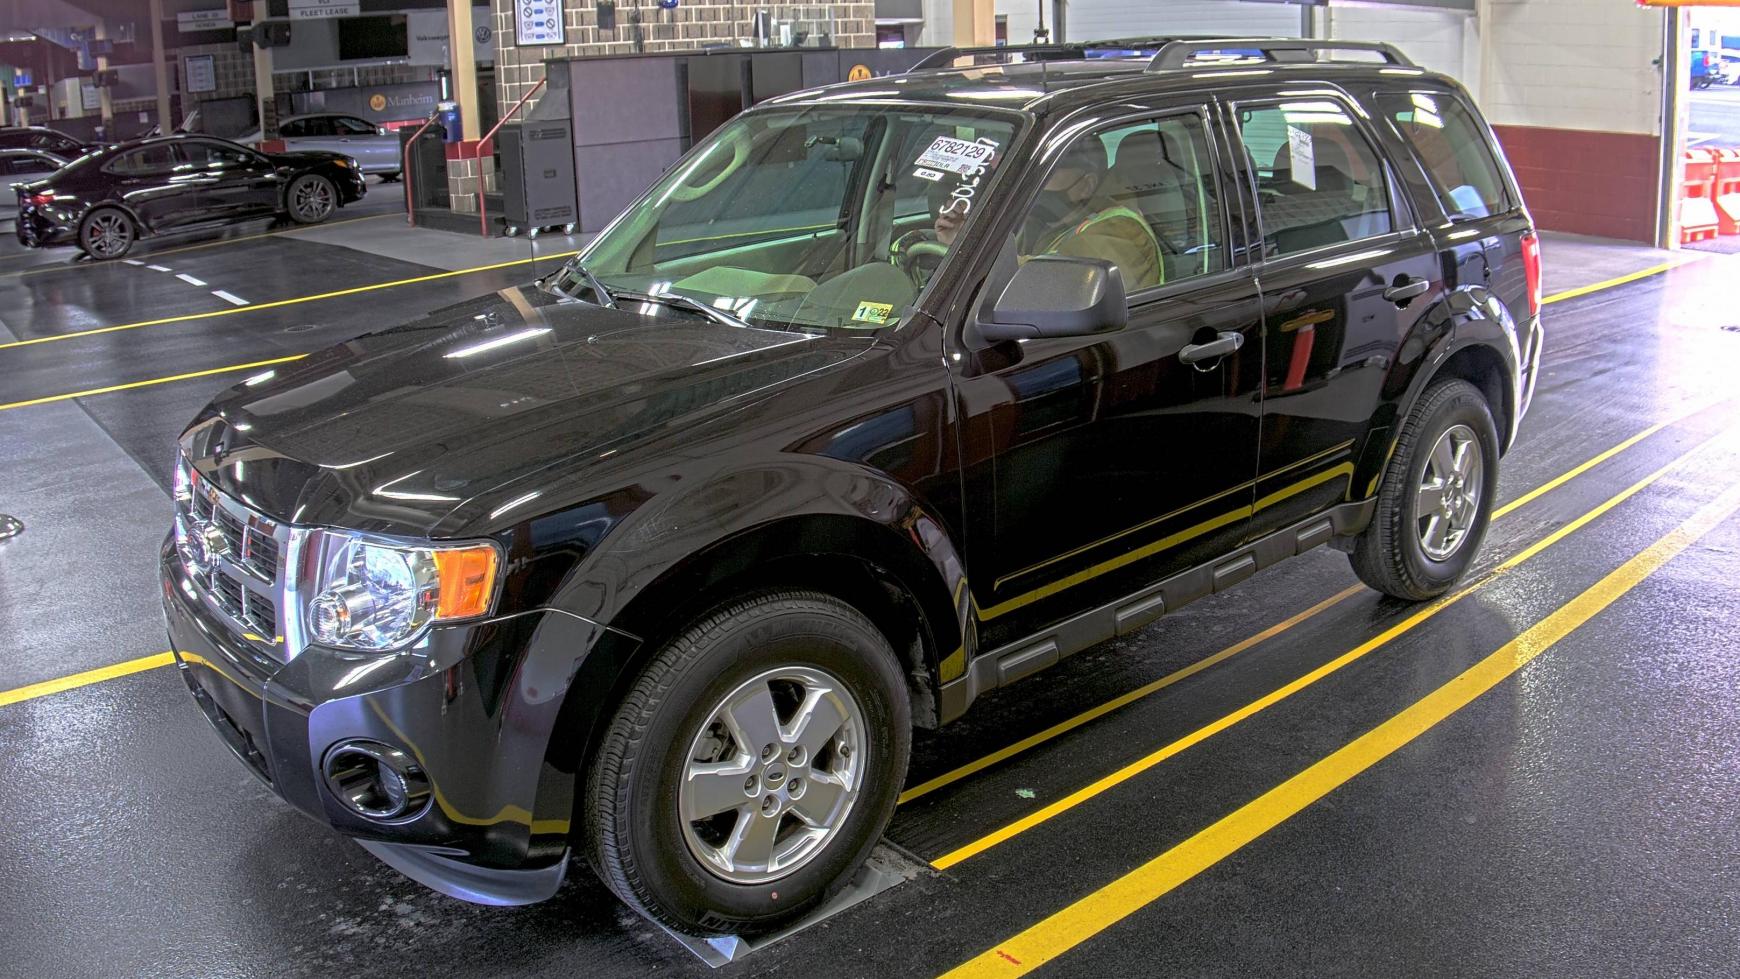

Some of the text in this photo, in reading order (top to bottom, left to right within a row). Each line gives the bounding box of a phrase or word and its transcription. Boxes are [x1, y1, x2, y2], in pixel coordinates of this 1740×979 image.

[300, 8, 349, 17] FLEET LEASE
[387, 94, 433, 106] Manheim
[931, 139, 986, 159] 6782129
[859, 307, 888, 317] 1 22
